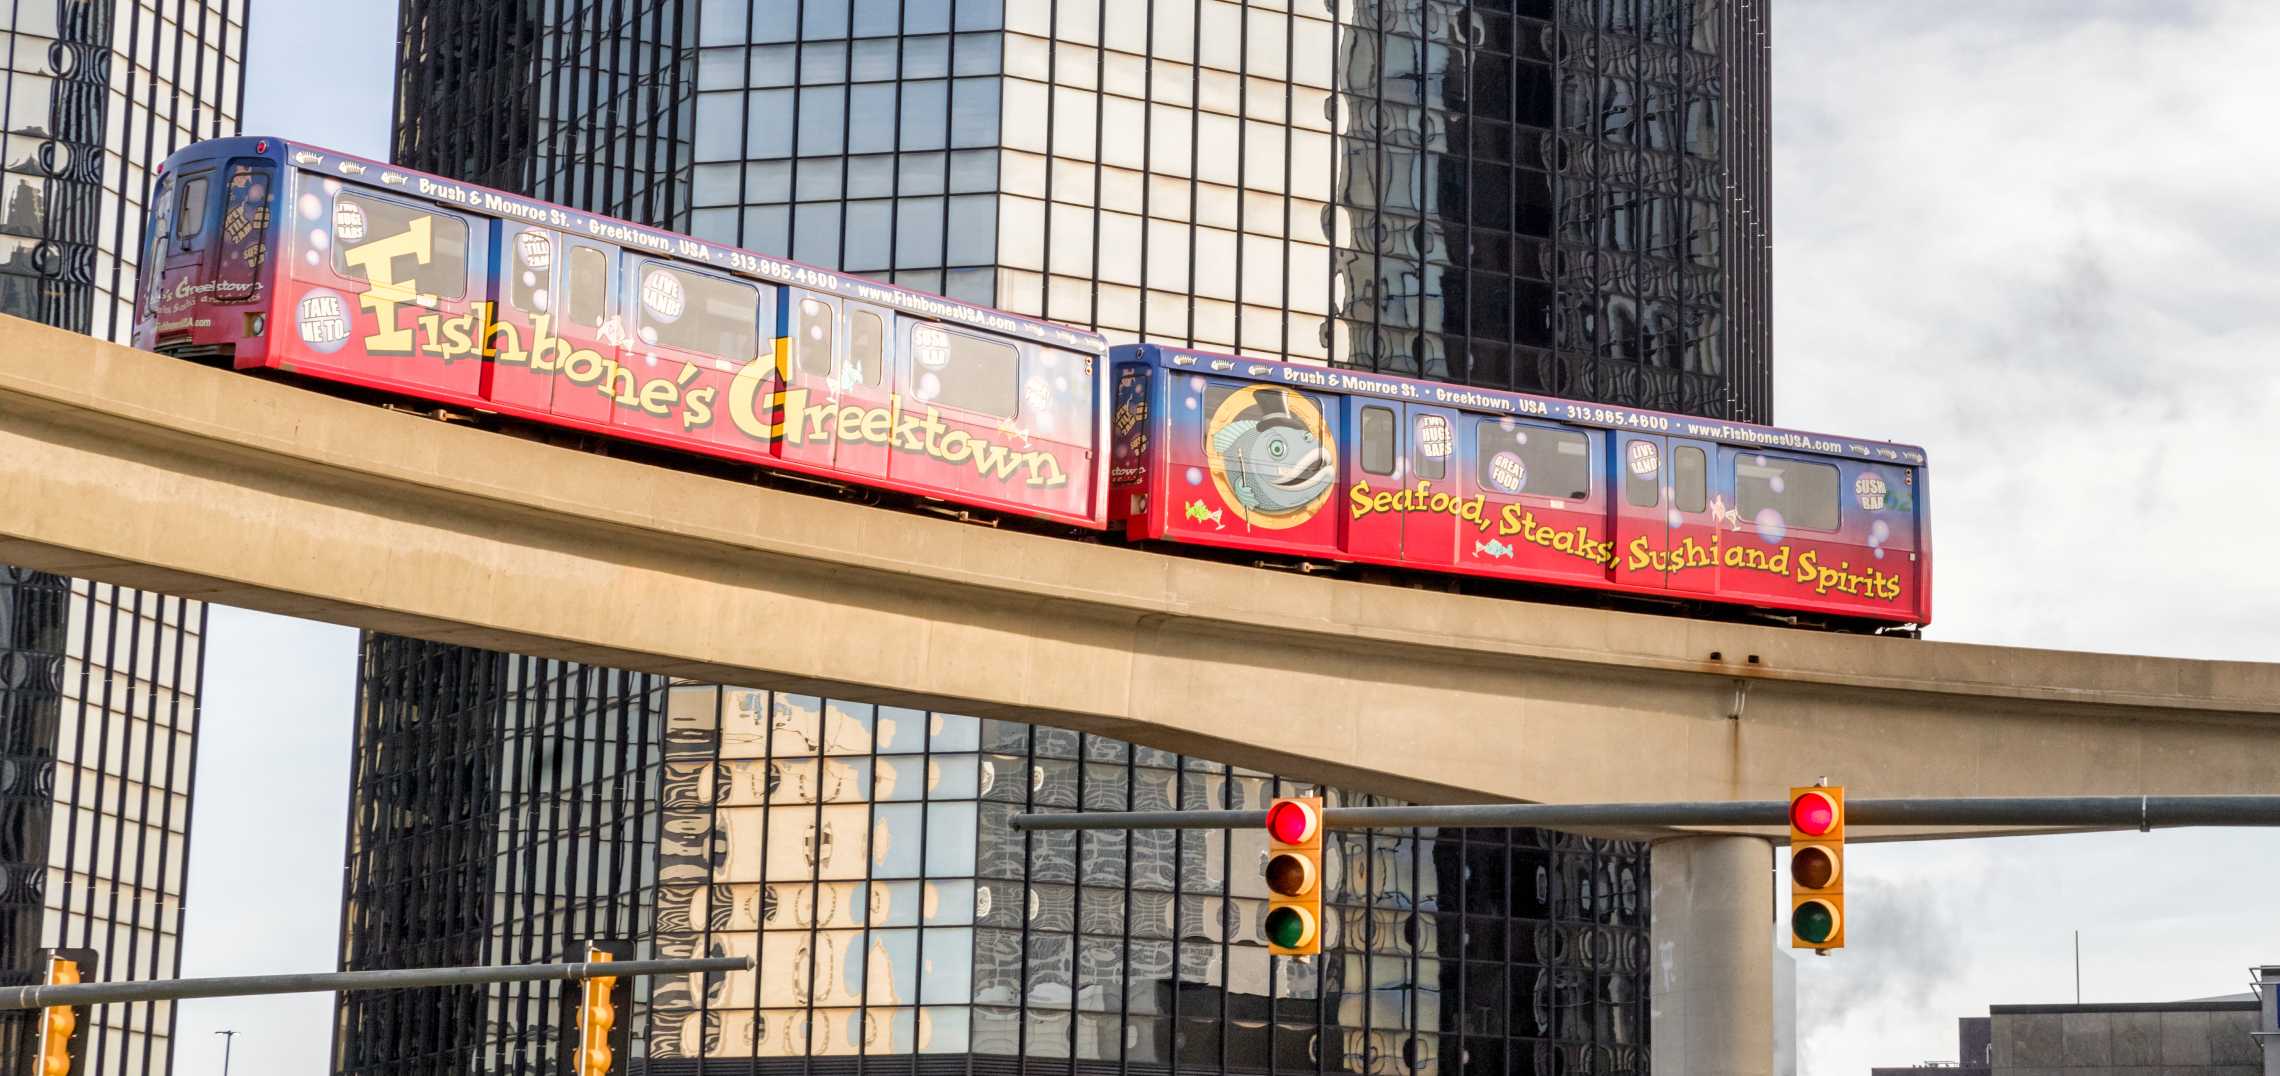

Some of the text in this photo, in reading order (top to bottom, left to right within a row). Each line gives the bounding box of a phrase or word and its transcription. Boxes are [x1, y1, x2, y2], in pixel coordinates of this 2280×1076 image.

[419, 177, 465, 204] Brush
[469, 190, 482, 206] &
[485, 193, 547, 222] Monroe
[550, 208, 570, 228] St.
[588, 219, 675, 254] Greektown,
[680, 239, 710, 261] USA
[858, 284, 1017, 333] www.FishbonesUSA.com
[652, 273, 679, 297] LIVE
[303, 296, 340, 319] TAKE
[643, 287, 681, 316] BANDS
[300, 321, 323, 342] ME
[345, 215, 1067, 486] Fishbone's Greektown
[1283, 367, 1842, 453] Brush & Monroe St. Greektown, USA 313.965.4600 www.FishbonesUSA.com
[1632, 445, 1654, 459] LIVE
[1492, 466, 1520, 491] FOOD
[1495, 455, 1525, 480] GREAT
[1350, 480, 1901, 600] Seafood, Steaks, Sushi and Spirits
